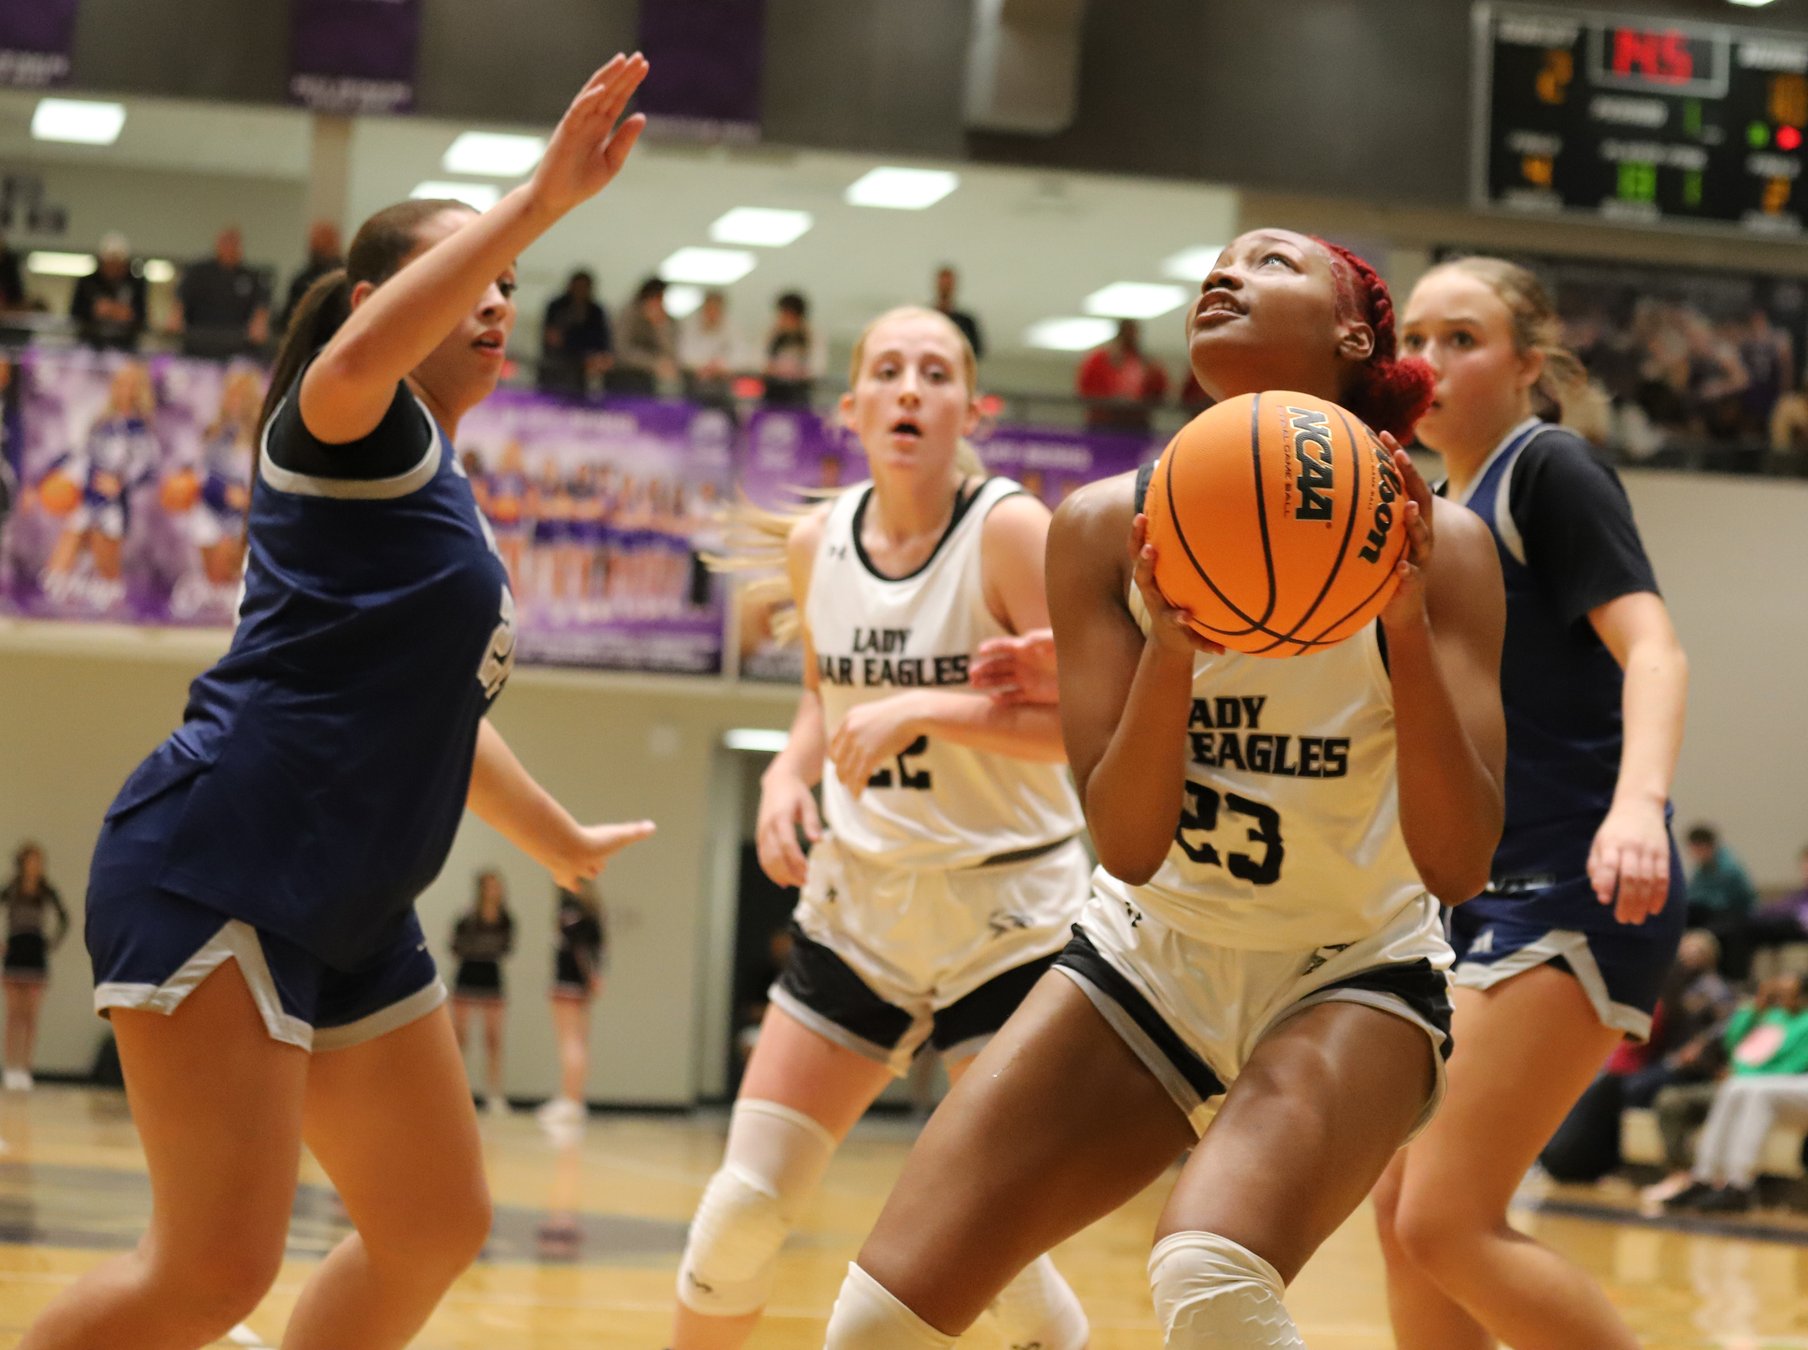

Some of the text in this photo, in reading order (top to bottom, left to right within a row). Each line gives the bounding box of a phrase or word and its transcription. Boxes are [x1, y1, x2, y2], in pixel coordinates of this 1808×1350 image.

[1286, 406, 1335, 521] NCAA
[1282, 483, 1291, 517] BALL
[853, 628, 911, 652] LADY
[817, 654, 970, 687] AR EAGLES
[1187, 695, 1267, 729] ADY
[1188, 731, 1350, 779] EAGLES
[1175, 779, 1284, 885] 23
